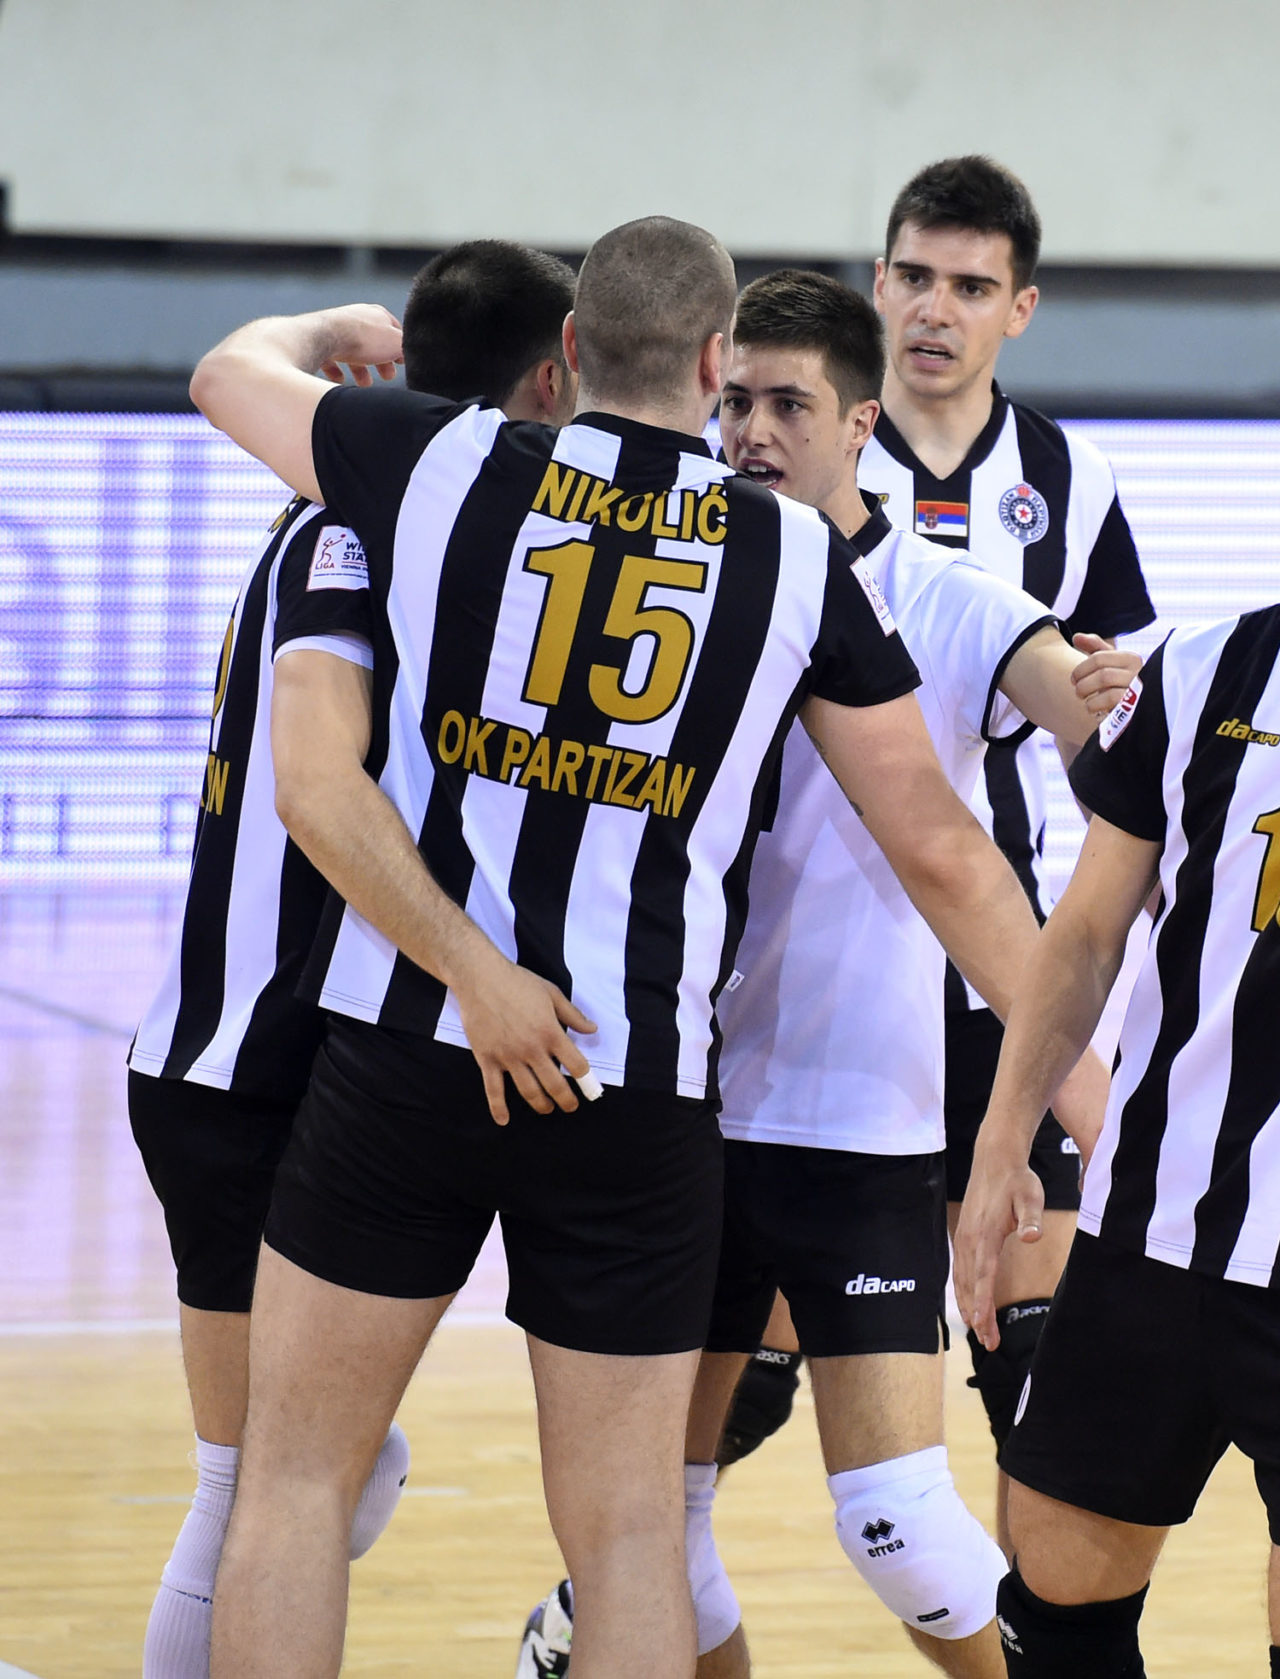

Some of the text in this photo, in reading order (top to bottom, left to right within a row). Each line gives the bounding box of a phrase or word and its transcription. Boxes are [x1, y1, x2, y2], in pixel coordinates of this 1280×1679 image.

[531, 461, 728, 544] NIKOLIĆ
[315, 562, 335, 570] LIGA
[525, 541, 704, 722] 15
[437, 709, 696, 818] OK PARTIZAN
[867, 1538, 905, 1558] errea
